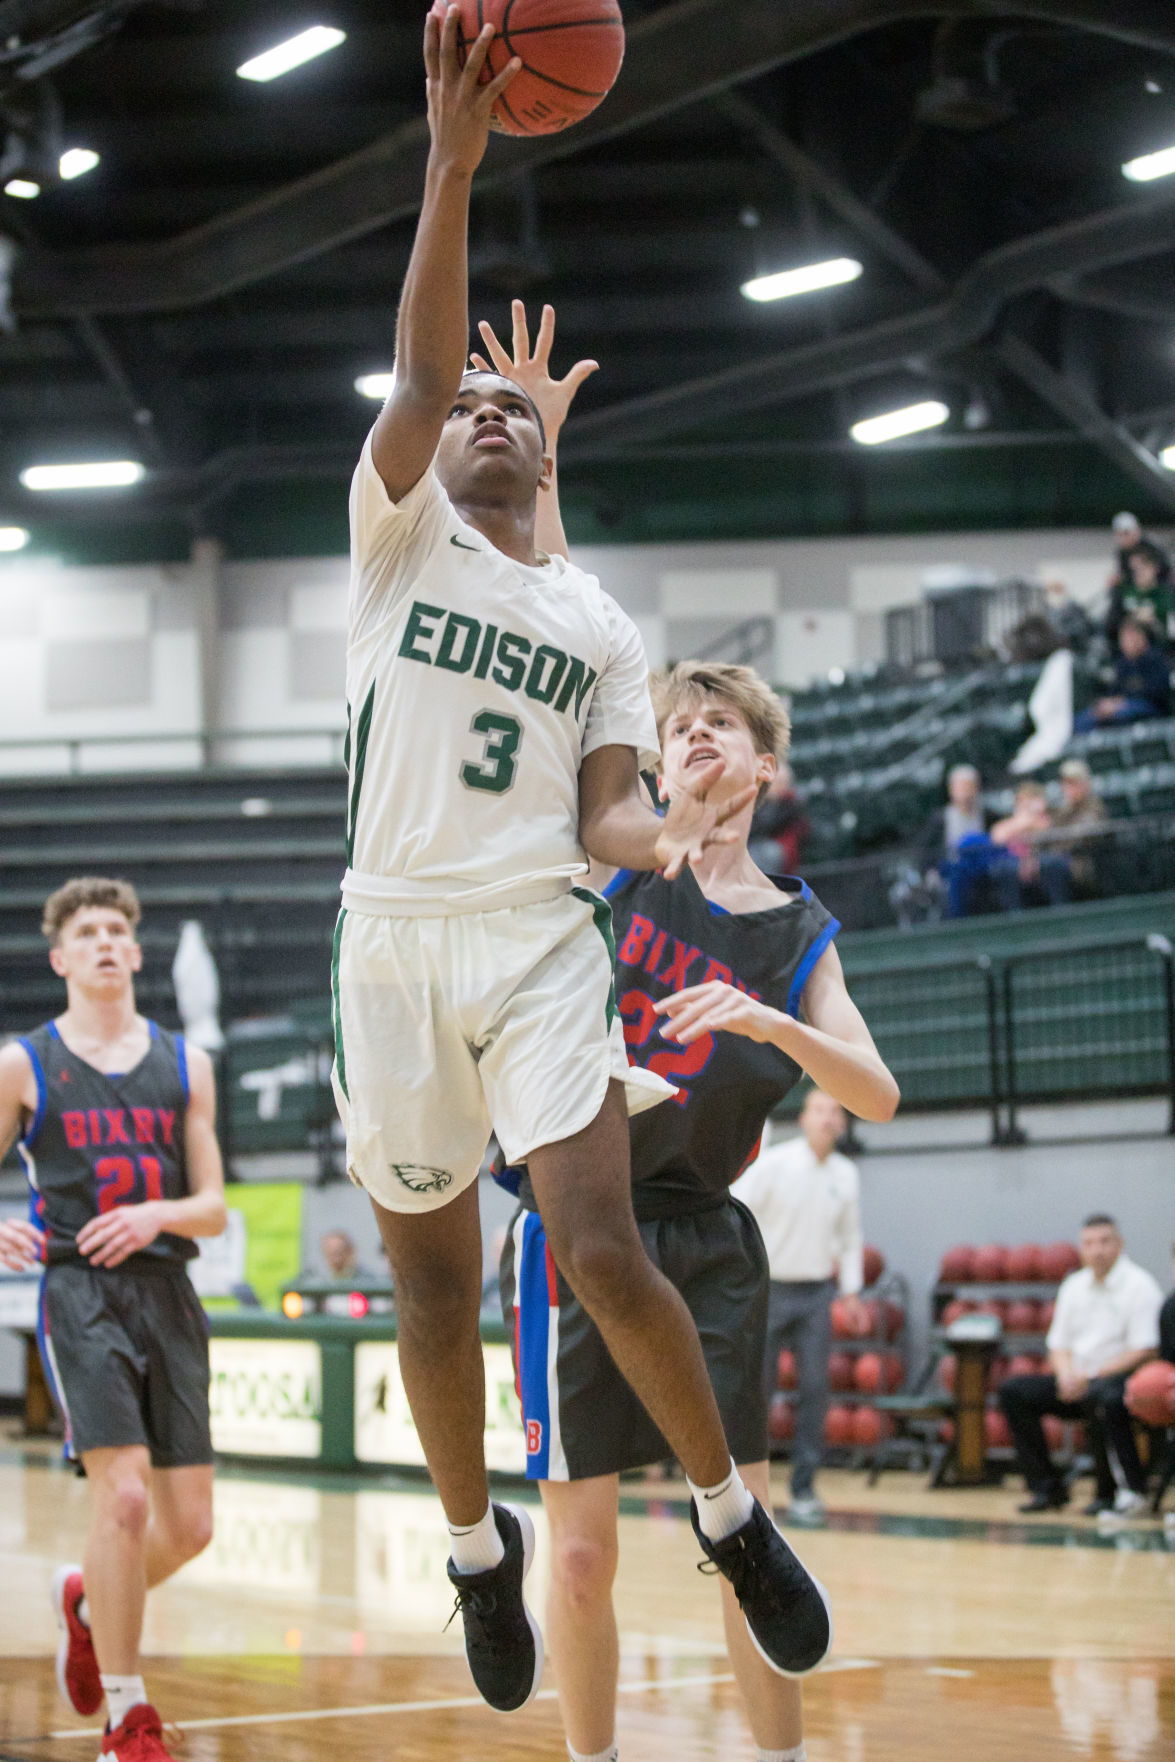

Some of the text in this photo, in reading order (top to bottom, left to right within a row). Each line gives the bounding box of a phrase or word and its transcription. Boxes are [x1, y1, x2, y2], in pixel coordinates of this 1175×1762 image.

[398, 600, 597, 724] EDISON
[458, 707, 525, 796] 3
[617, 912, 761, 1002] BIX
[61, 1106, 176, 1149] BIXBY
[94, 1155, 164, 1216] 21
[526, 1418, 543, 1456] B
